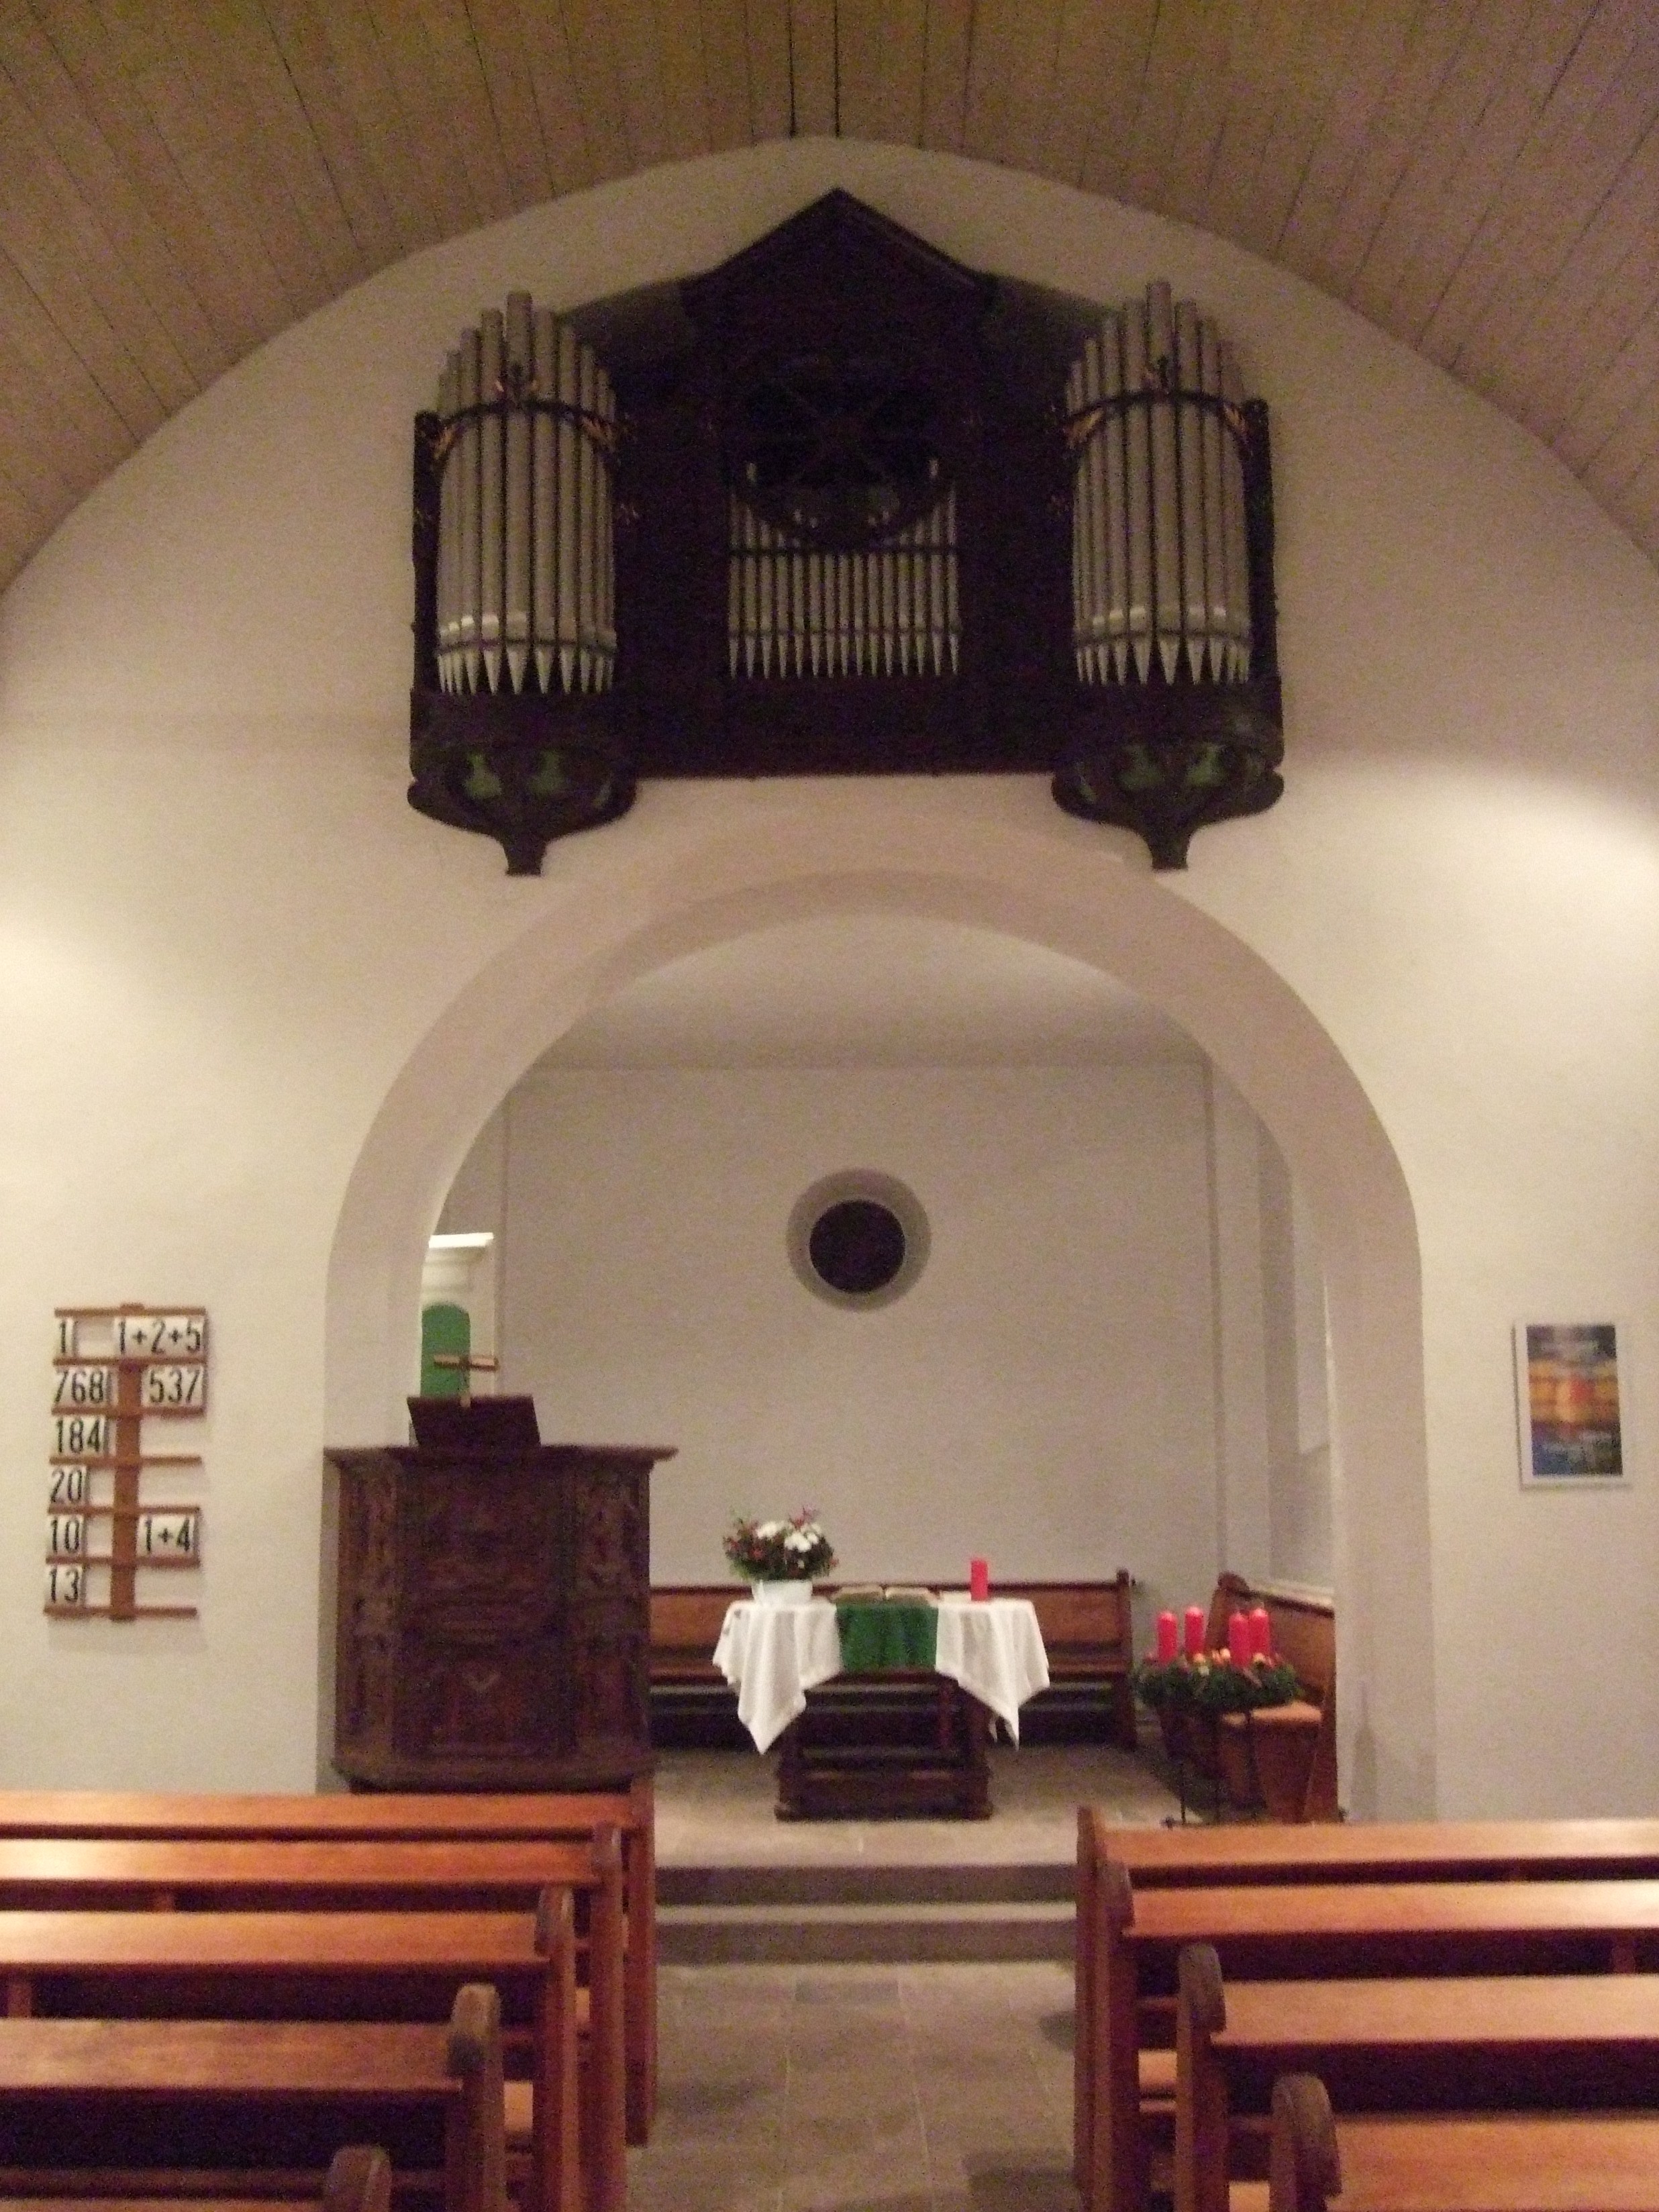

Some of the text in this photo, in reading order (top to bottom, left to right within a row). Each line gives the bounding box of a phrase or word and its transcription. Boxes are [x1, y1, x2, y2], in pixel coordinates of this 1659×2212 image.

[54, 1368, 201, 1403] 768 537
[56, 1417, 101, 1454] 184
[50, 1468, 83, 1504] 20
[51, 1518, 190, 1554] 10 1+4
[50, 1568, 79, 1603] 13
